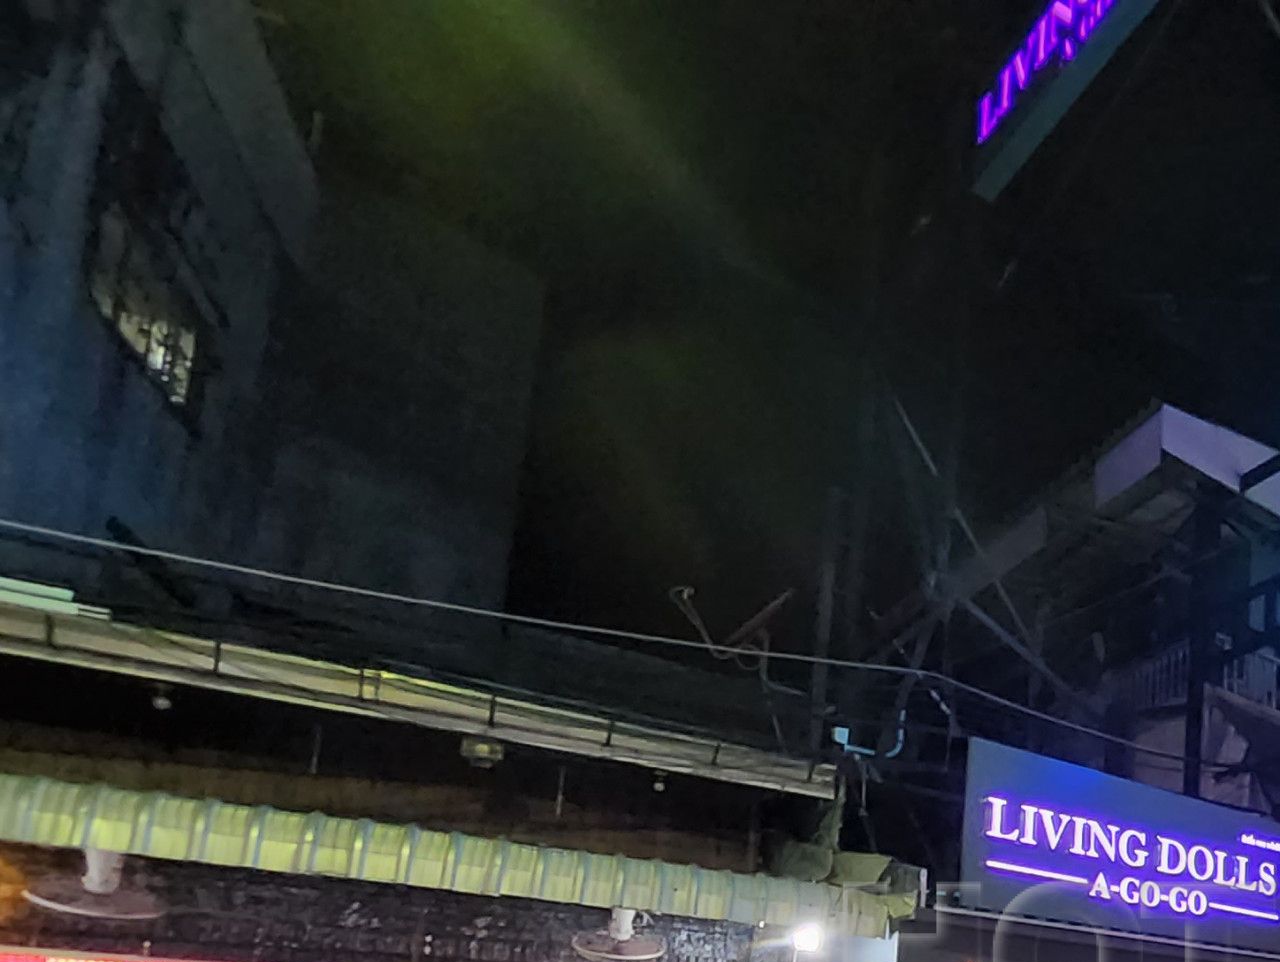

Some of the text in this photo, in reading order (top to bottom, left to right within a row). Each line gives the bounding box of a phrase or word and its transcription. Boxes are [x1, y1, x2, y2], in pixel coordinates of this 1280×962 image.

[985, 796, 1277, 897] LIVING DOLLS
[1089, 872, 1208, 916] A-GO-GO
